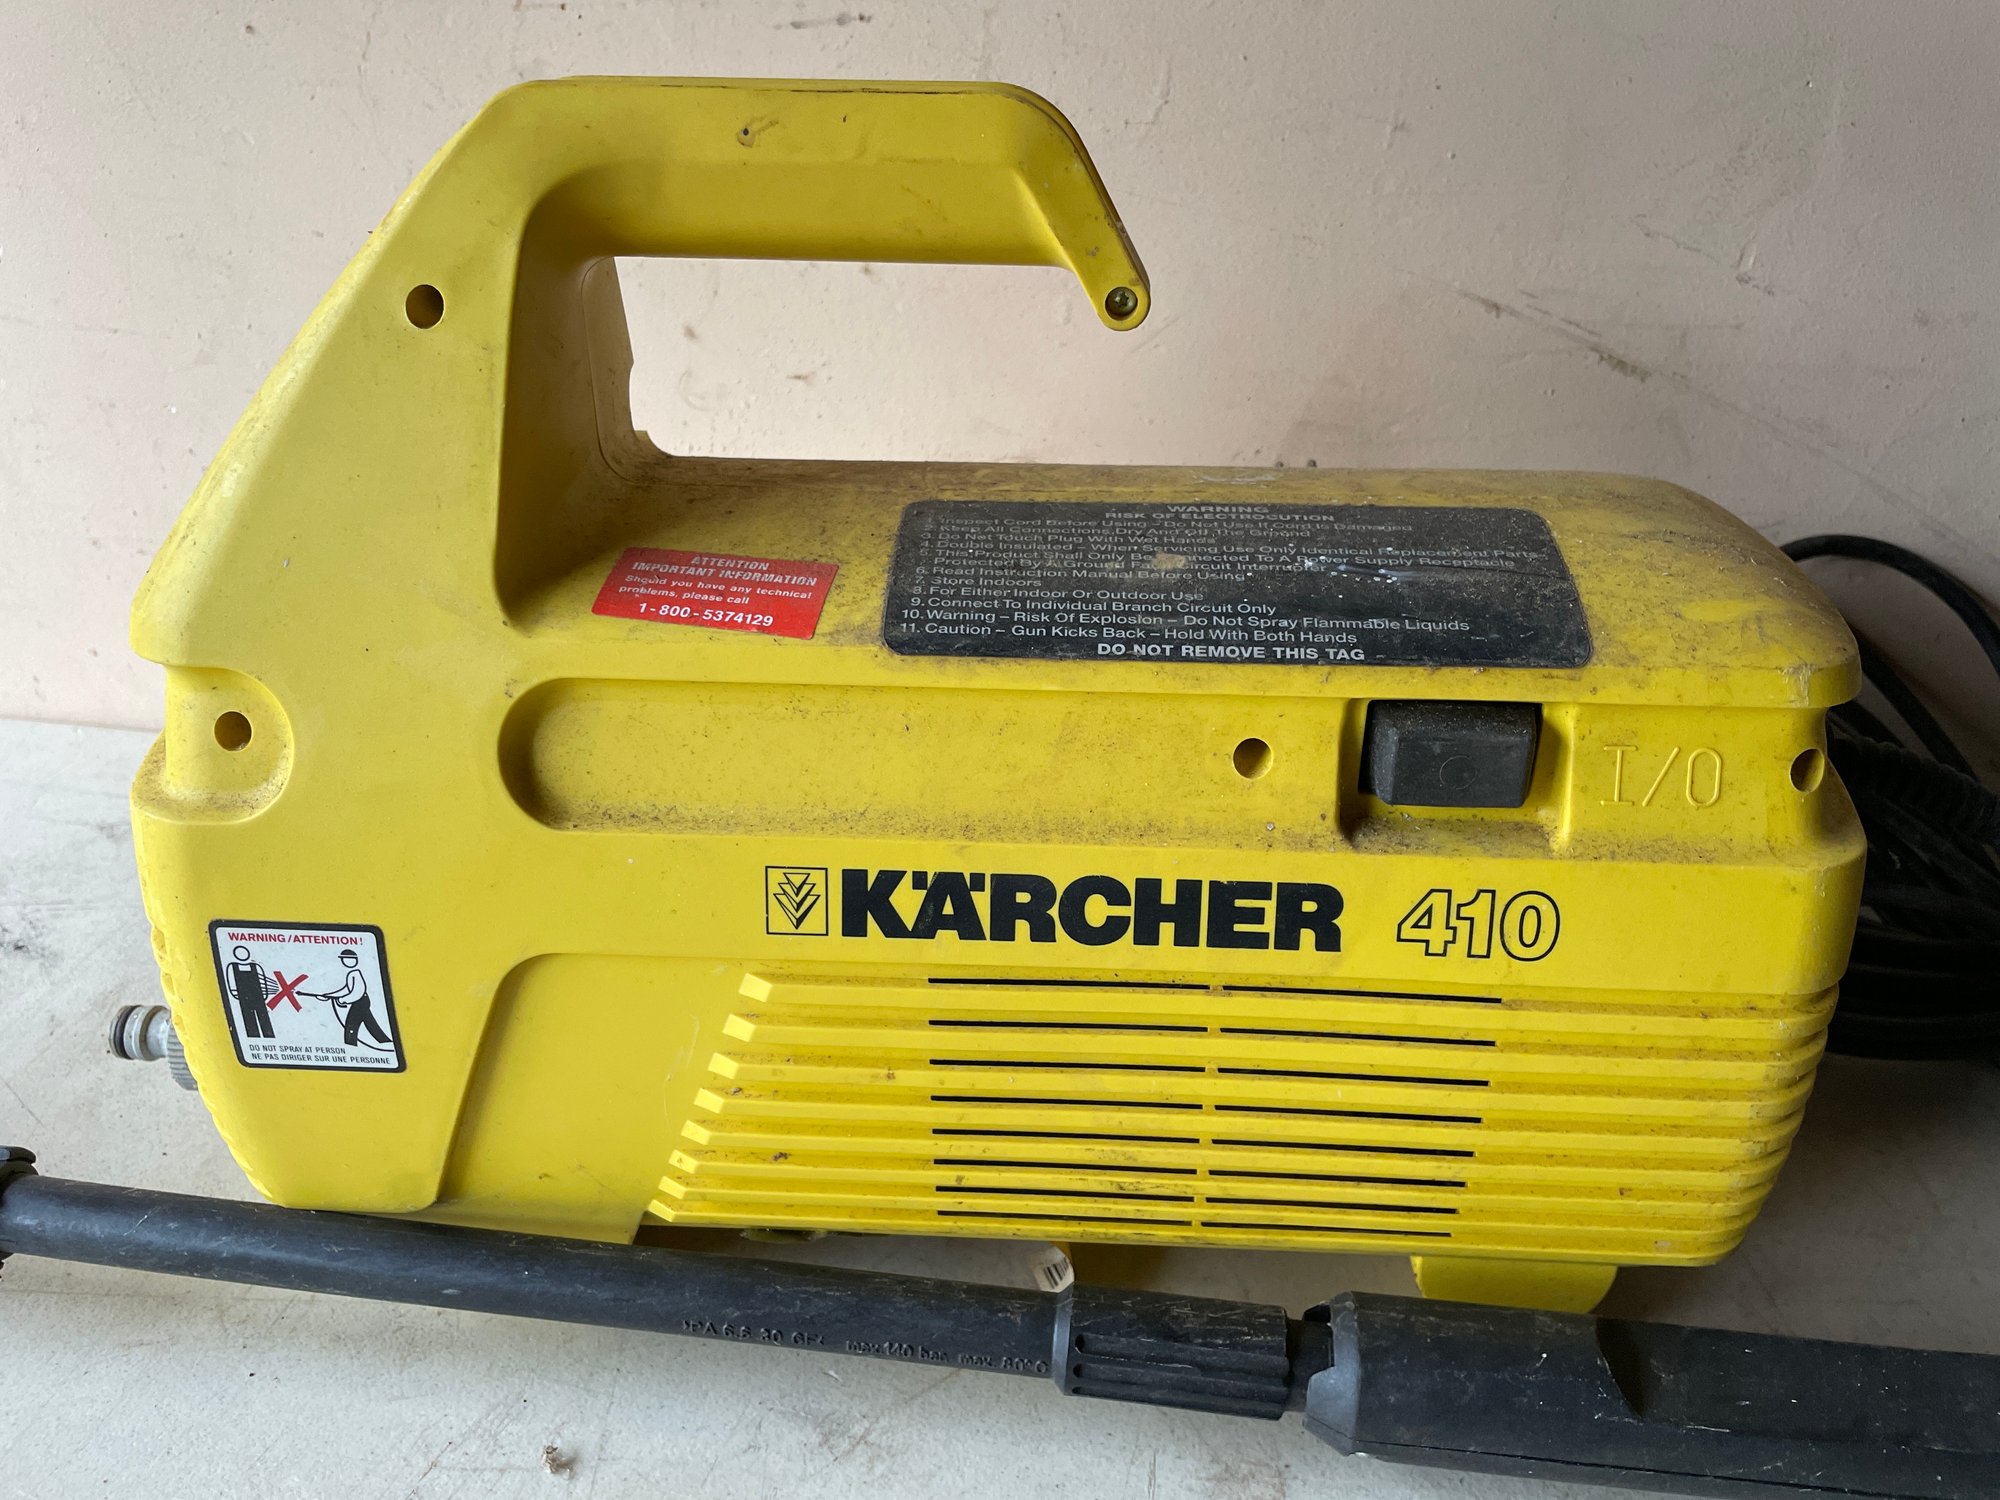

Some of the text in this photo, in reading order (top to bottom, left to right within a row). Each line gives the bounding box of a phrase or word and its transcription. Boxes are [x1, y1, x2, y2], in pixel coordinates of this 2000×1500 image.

[1166, 505, 1269, 513] WARNING
[1181, 513, 1335, 521] ELECTROCUTION
[1003, 518, 1042, 526] Cord
[1102, 519, 1148, 528] Using
[1164, 520, 1187, 528] Do
[1190, 520, 1218, 528] Not
[1222, 521, 1254, 529] Use
[964, 533, 993, 541] Not
[998, 534, 1043, 542] Touch
[1047, 534, 1083, 544] Plug
[1088, 535, 1124, 543] With
[1164, 536, 1216, 544] Hands
[1147, 528, 1180, 536] And
[936, 541, 994, 549] Double
[999, 542, 1073, 551] Insulated
[1090, 543, 1138, 551] When
[1142, 544, 1218, 554] Servicing
[1222, 545, 1255, 553] Use
[1258, 545, 1297, 555] Only
[1302, 546, 1373, 556] Identical
[690, 556, 770, 571] ATTENTION
[933, 557, 1015, 566] Protected
[1019, 558, 1042, 569] By
[1063, 560, 1125, 569] Ground
[935, 549, 969, 557] This
[974, 550, 1041, 559] Product
[1043, 551, 1084, 560] Shall
[1087, 551, 1125, 561] Only
[1130, 552, 1152, 561] Be
[1254, 553, 1275, 562] To
[1278, 554, 1292, 563] A
[1354, 556, 1413, 567] Supply
[1418, 557, 1516, 568] Receptacle
[631, 561, 818, 587] IMPORTANT INFORMATION
[915, 566, 1246, 582] 6. Read Instruction Manual Before Using
[930, 576, 975, 586] Store
[979, 577, 1042, 587] Indoors
[618, 585, 751, 605] problems, please call
[625, 574, 813, 600] Should you have any technical
[912, 585, 1204, 601] 8. For Either Indoor Or Outdoor Use
[910, 596, 1277, 616] 9. Connect To Individual Branch Circuit Only
[901, 608, 924, 620] 10.
[926, 609, 996, 624] Warning
[1013, 611, 1050, 623] Risk
[1054, 612, 1076, 624] Of
[1079, 612, 1163, 626] Explosion
[1183, 615, 1208, 626] Do
[1212, 615, 1244, 627] Not
[1247, 616, 1298, 630] Spray
[1302, 617, 1401, 630] Flammable
[1404, 618, 1470, 633] Liquids
[900, 622, 922, 634] 11.
[924, 622, 992, 636] Caution
[1011, 624, 1047, 637] Gun
[1051, 625, 1099, 638] Kicks
[1102, 626, 1147, 639] Back
[1164, 628, 1205, 640] Hold
[1207, 629, 1249, 641] With
[1253, 630, 1295, 642] Both
[1299, 631, 1358, 644] Hands
[1097, 642, 1366, 661] DO NOT REMOVE THIS TAG
[840, 868, 1343, 952] KÄRCHER
[1396, 888, 1562, 962] 410
[249, 1044, 346, 1055] DO NOT SPRAY AT PERSON
[251, 1052, 391, 1065] NE PAS DIRIGER SUR UNE PERSONNE
